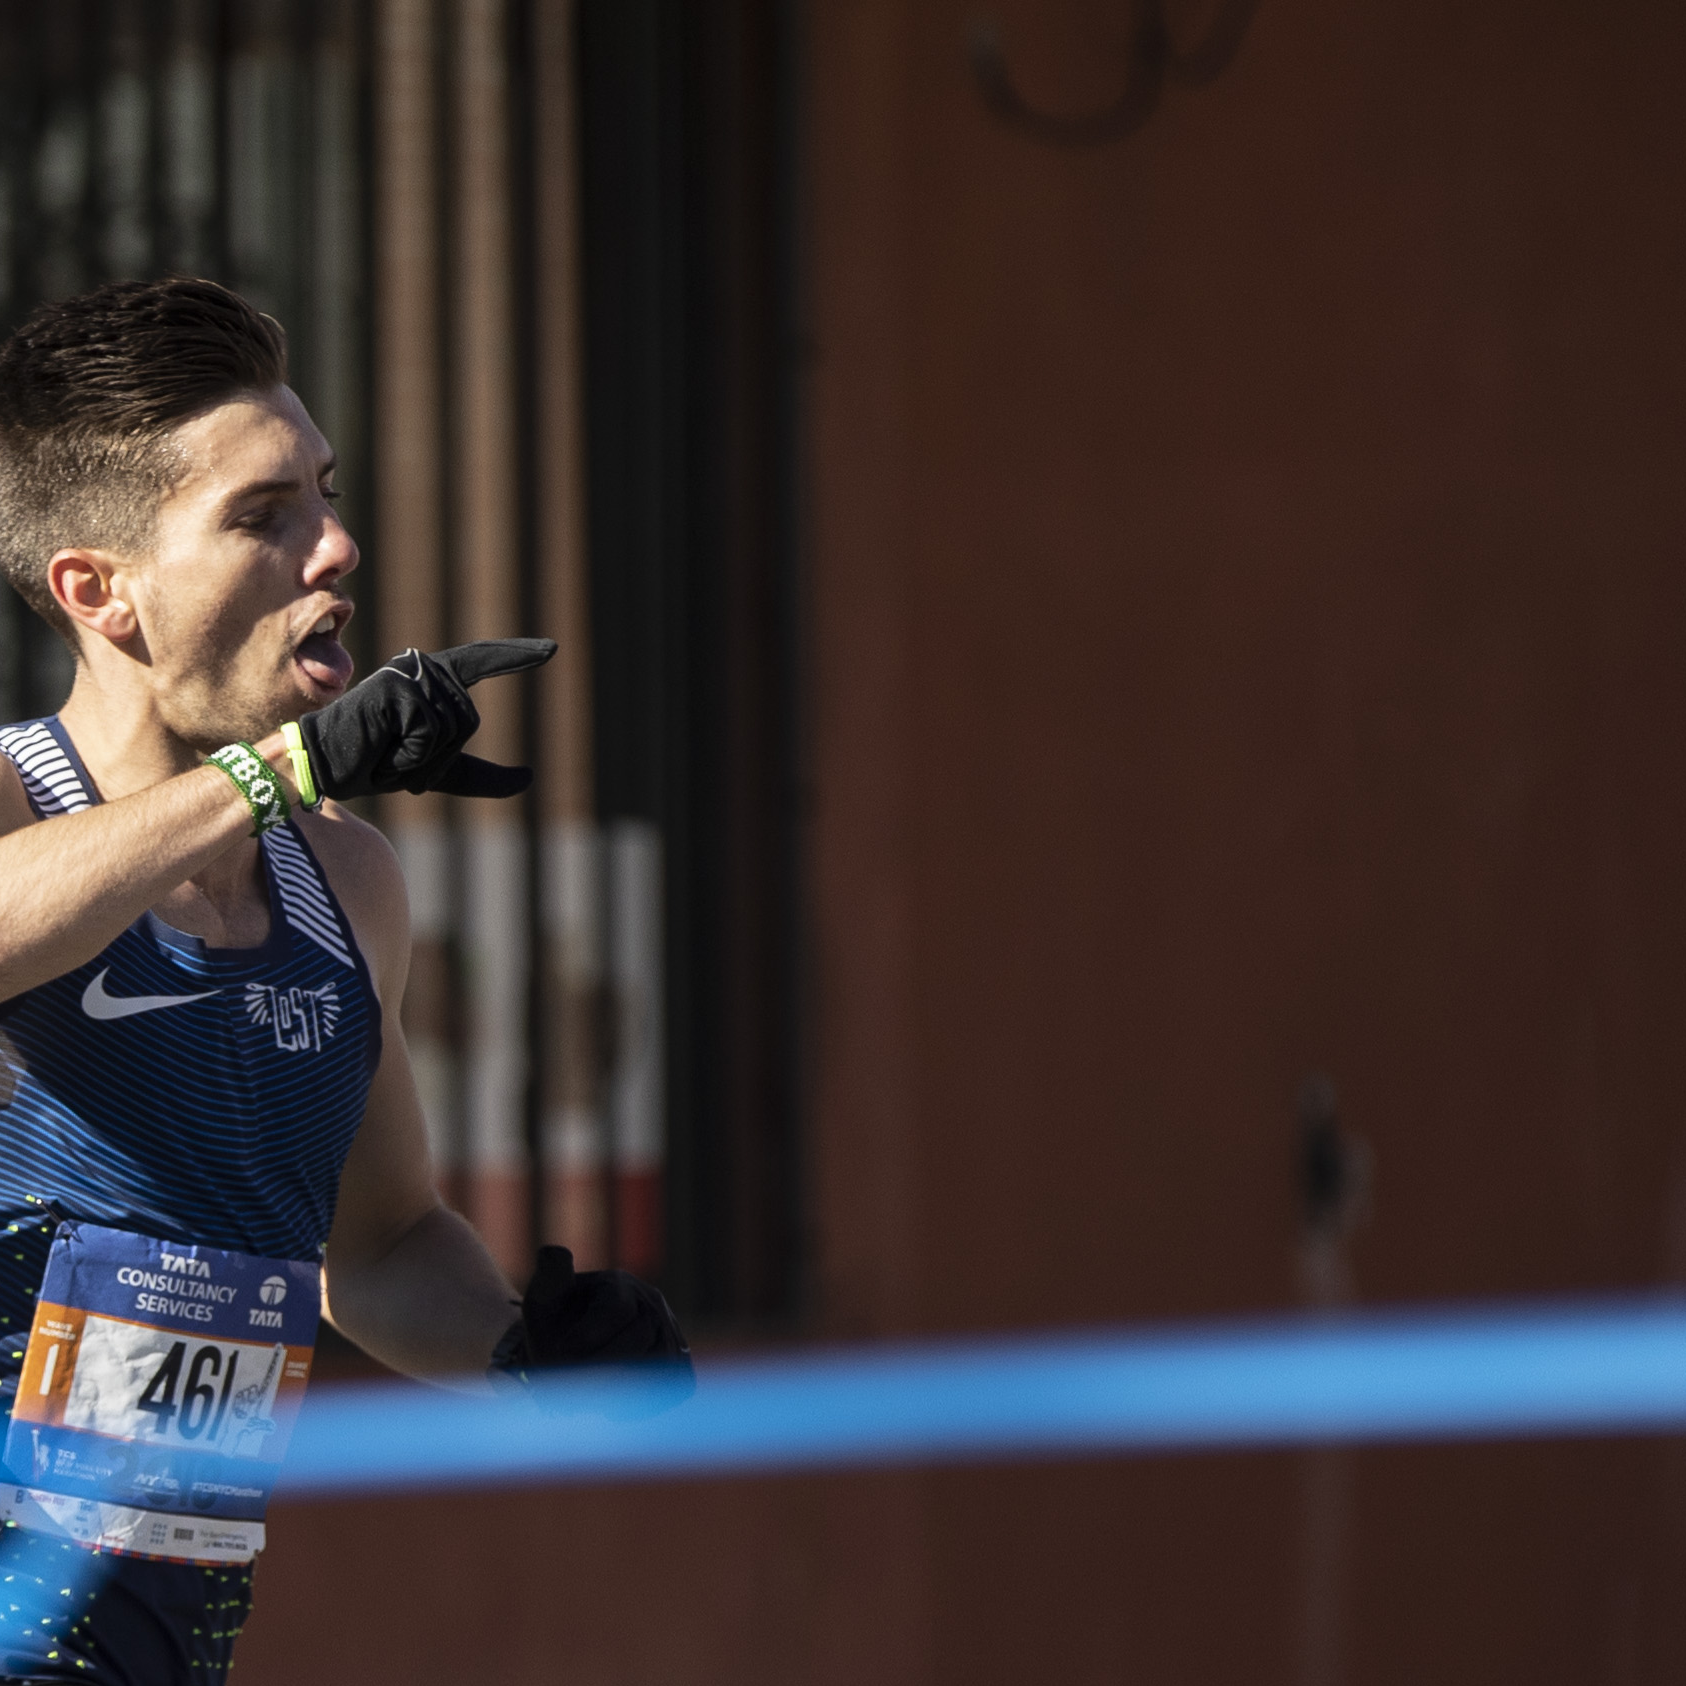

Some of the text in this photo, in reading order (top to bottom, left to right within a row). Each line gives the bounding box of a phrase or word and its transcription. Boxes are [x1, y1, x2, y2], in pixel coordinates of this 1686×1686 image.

[160, 1253, 211, 1278] TATA
[117, 1267, 237, 1304] CONSULTANCY
[135, 1293, 214, 1322] SERVICES
[249, 1308, 283, 1328] TATA
[136, 1341, 239, 1441] 461
